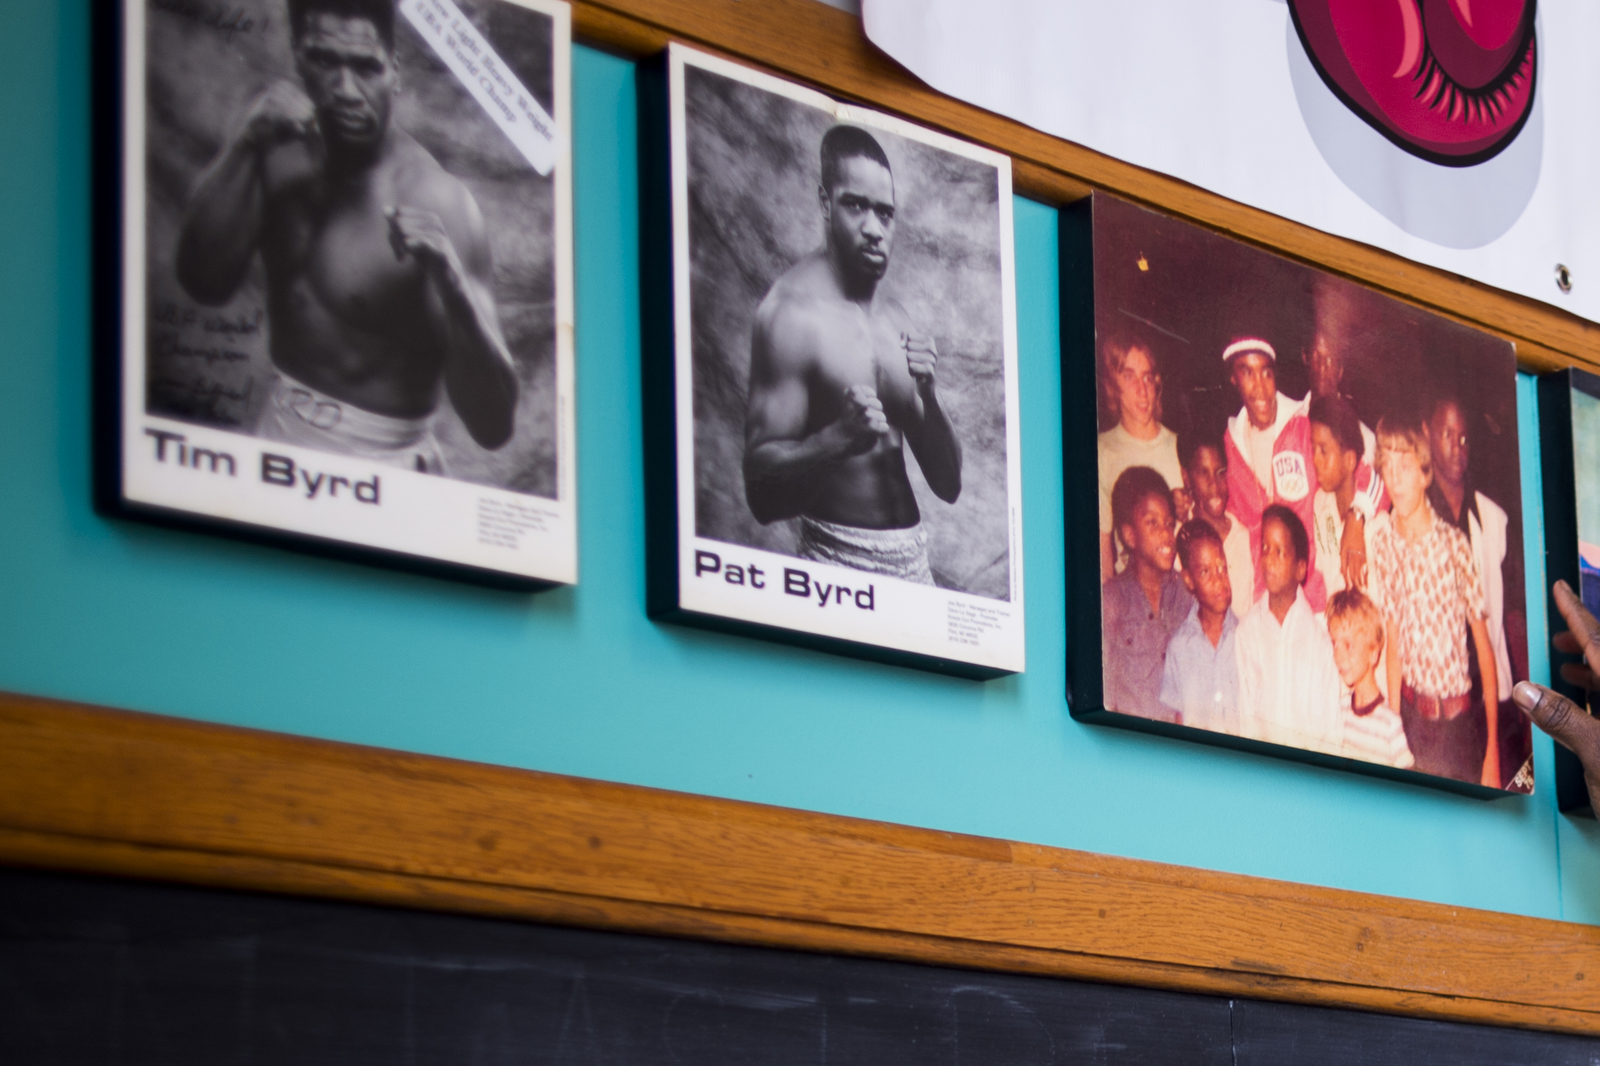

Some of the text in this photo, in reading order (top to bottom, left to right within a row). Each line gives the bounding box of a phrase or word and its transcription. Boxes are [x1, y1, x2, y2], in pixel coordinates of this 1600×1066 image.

[446, 32, 480, 78] World
[479, 75, 518, 124] Champ
[451, 18, 482, 57] Light
[481, 52, 514, 97] Heavy
[517, 93, 554, 143] Weight
[145, 427, 381, 506] Tim Byrd
[1275, 457, 1304, 477] USA
[695, 550, 875, 611] Pat Byrd
